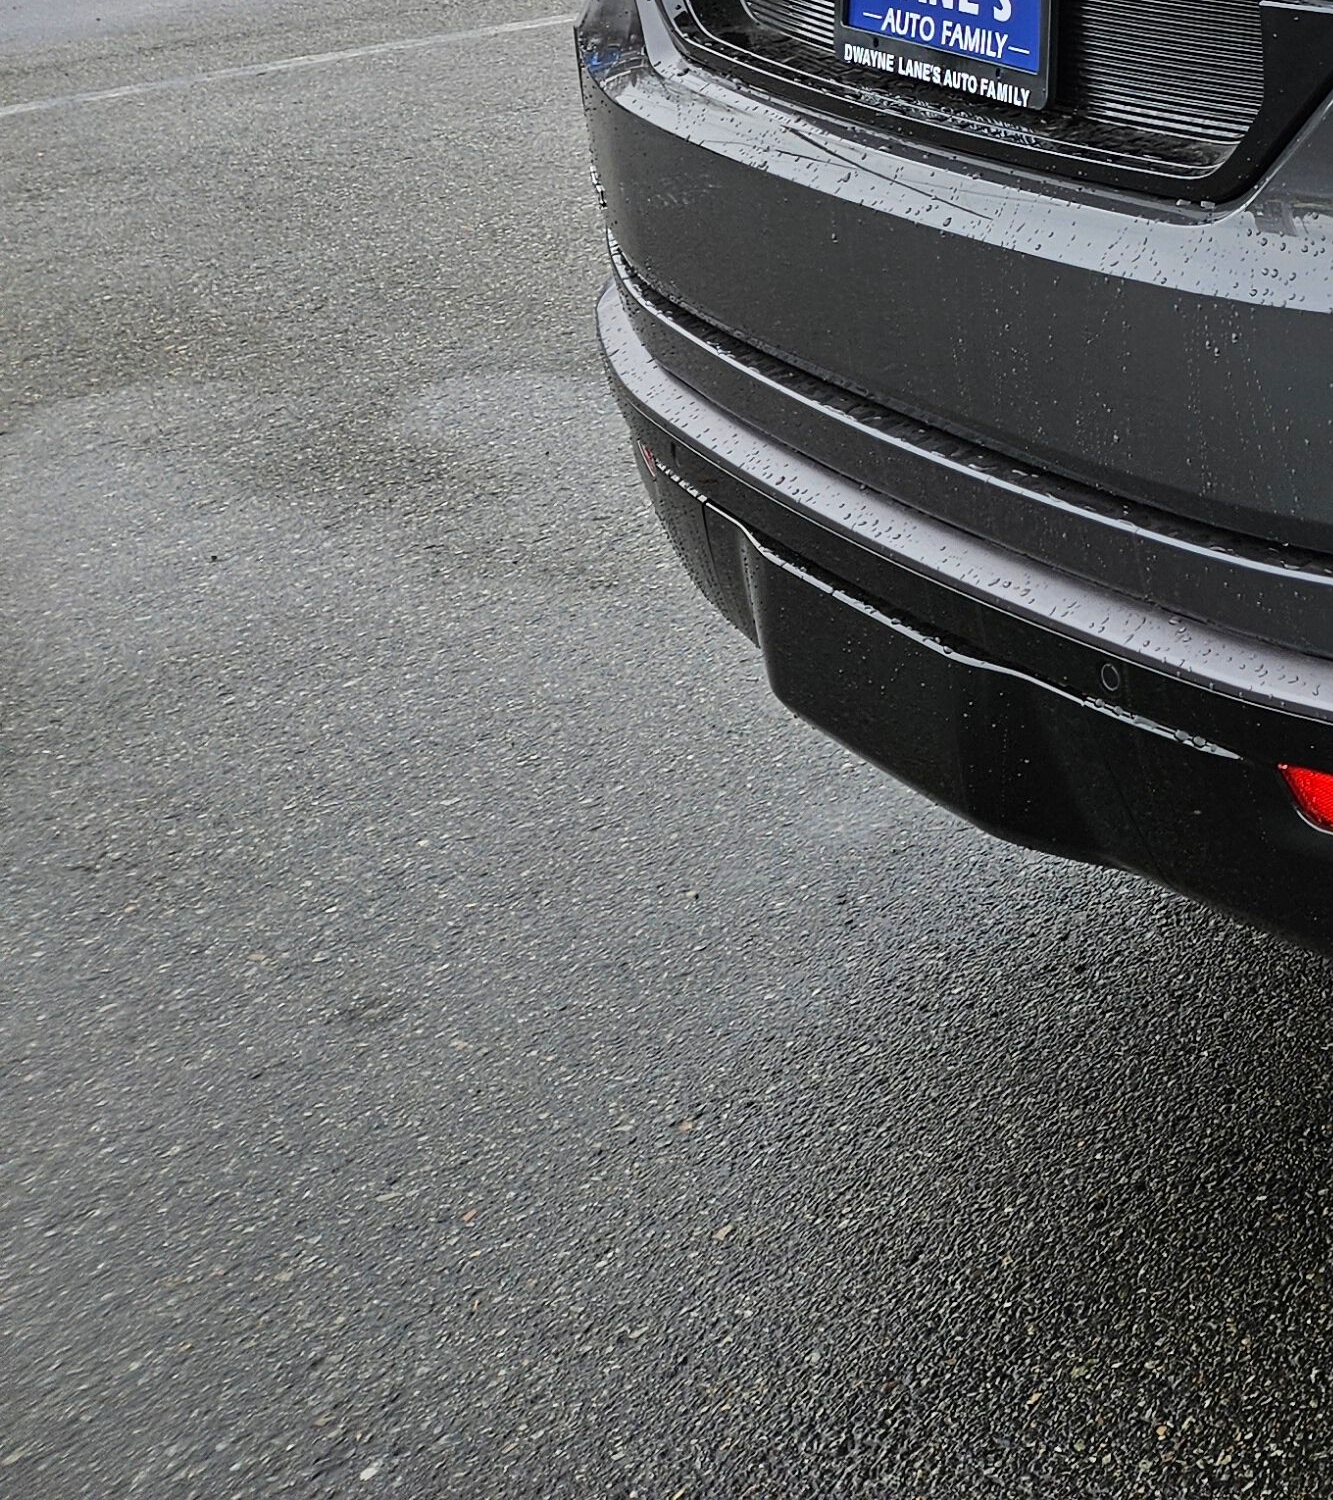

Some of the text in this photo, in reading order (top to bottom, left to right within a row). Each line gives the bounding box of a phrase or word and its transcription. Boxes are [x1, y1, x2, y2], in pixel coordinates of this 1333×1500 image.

[881, 7, 1009, 59] AUTO FAMILY
[844, 43, 1031, 108] DWAYNE LANE'S AUTO FAMILY
